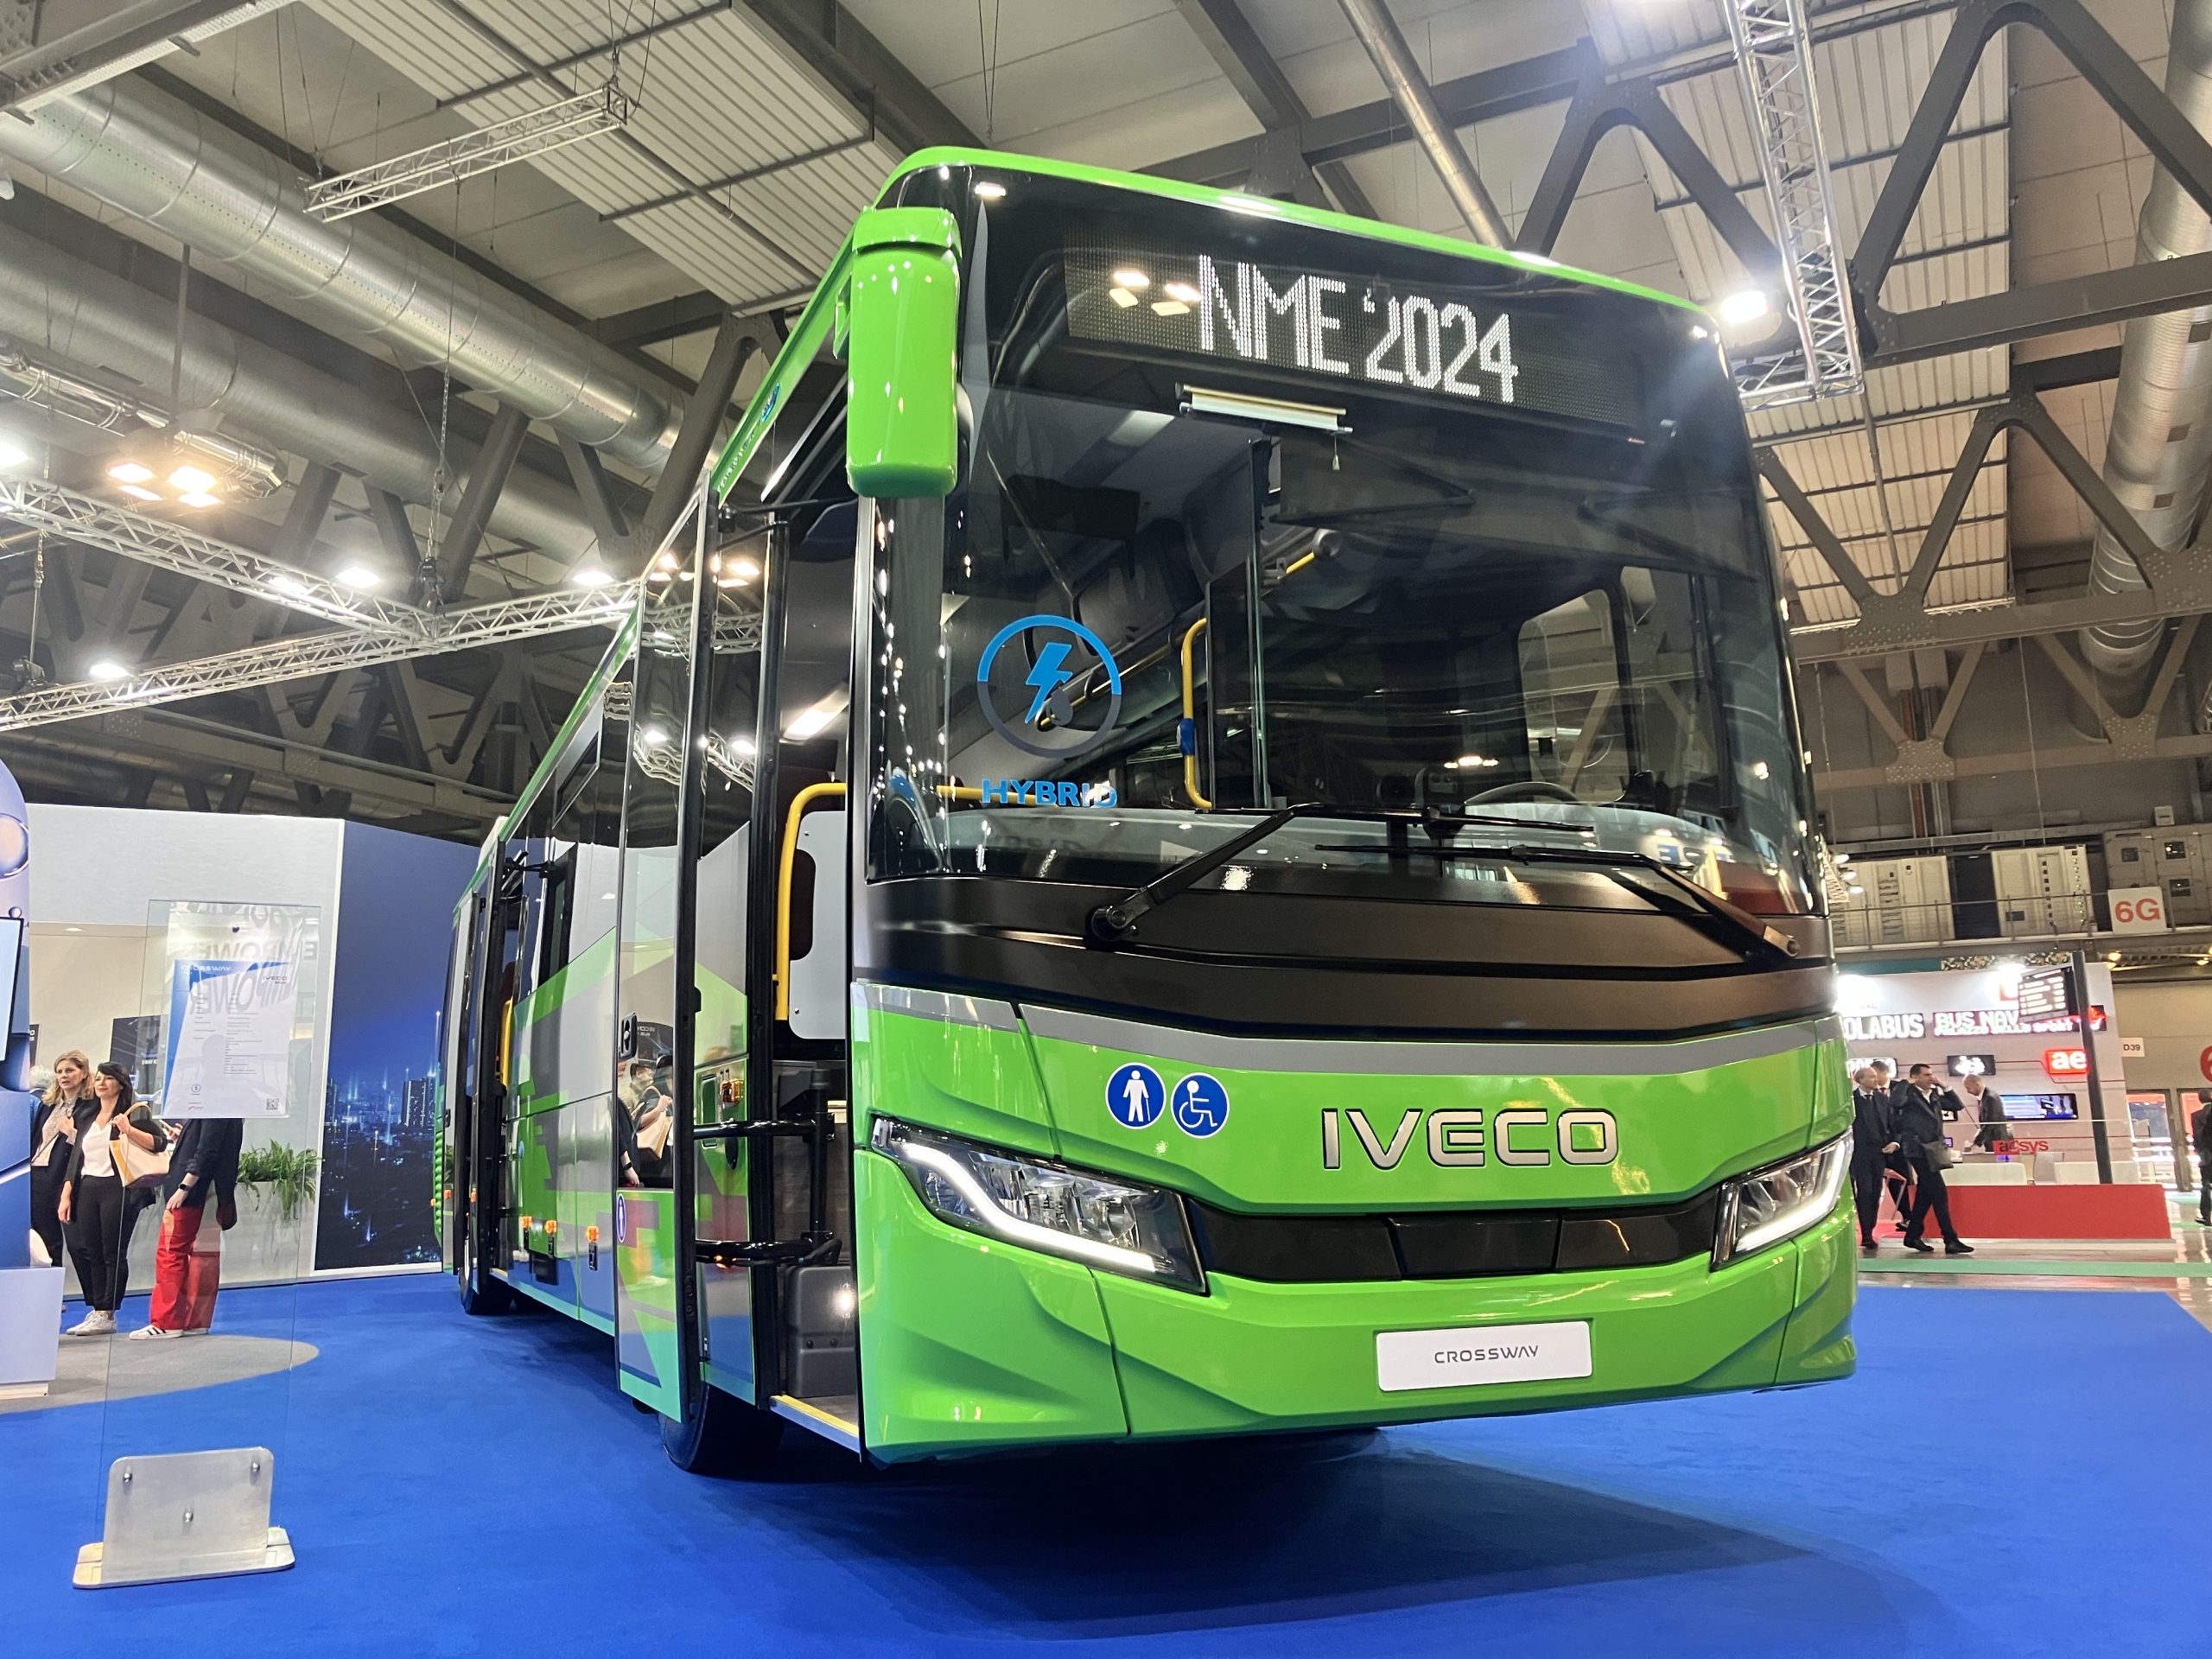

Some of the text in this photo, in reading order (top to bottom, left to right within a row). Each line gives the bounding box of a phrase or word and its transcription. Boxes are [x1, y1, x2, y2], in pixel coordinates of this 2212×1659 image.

[1199, 255, 1350, 375] NME
[982, 779, 1118, 809] HYBRID
[2115, 898, 2161, 924] 6G
[1935, 1012, 1975, 1029] BUS
[2123, 1043, 2141, 1052] D39
[1321, 1108, 1618, 1170] IVECO
[1434, 1344, 1539, 1364] CROSSWAY
